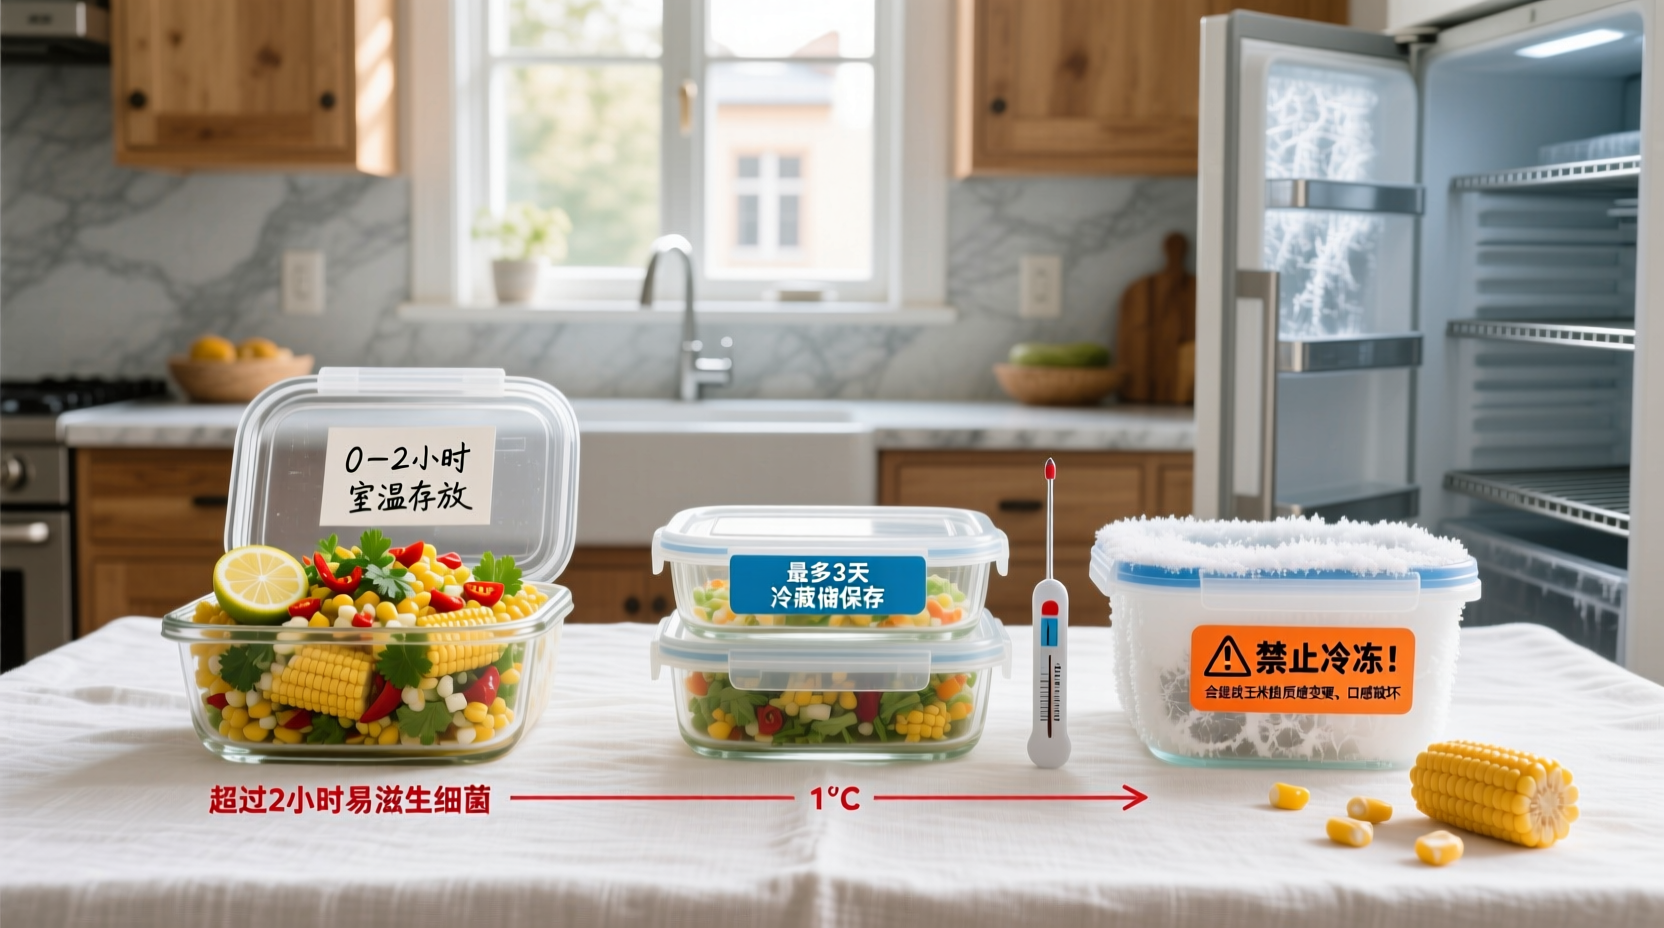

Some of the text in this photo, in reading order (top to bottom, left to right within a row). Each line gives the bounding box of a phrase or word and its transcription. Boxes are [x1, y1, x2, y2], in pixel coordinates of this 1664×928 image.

[349, 480, 473, 514] 室温存放
[786, 561, 870, 584] 最多3天
